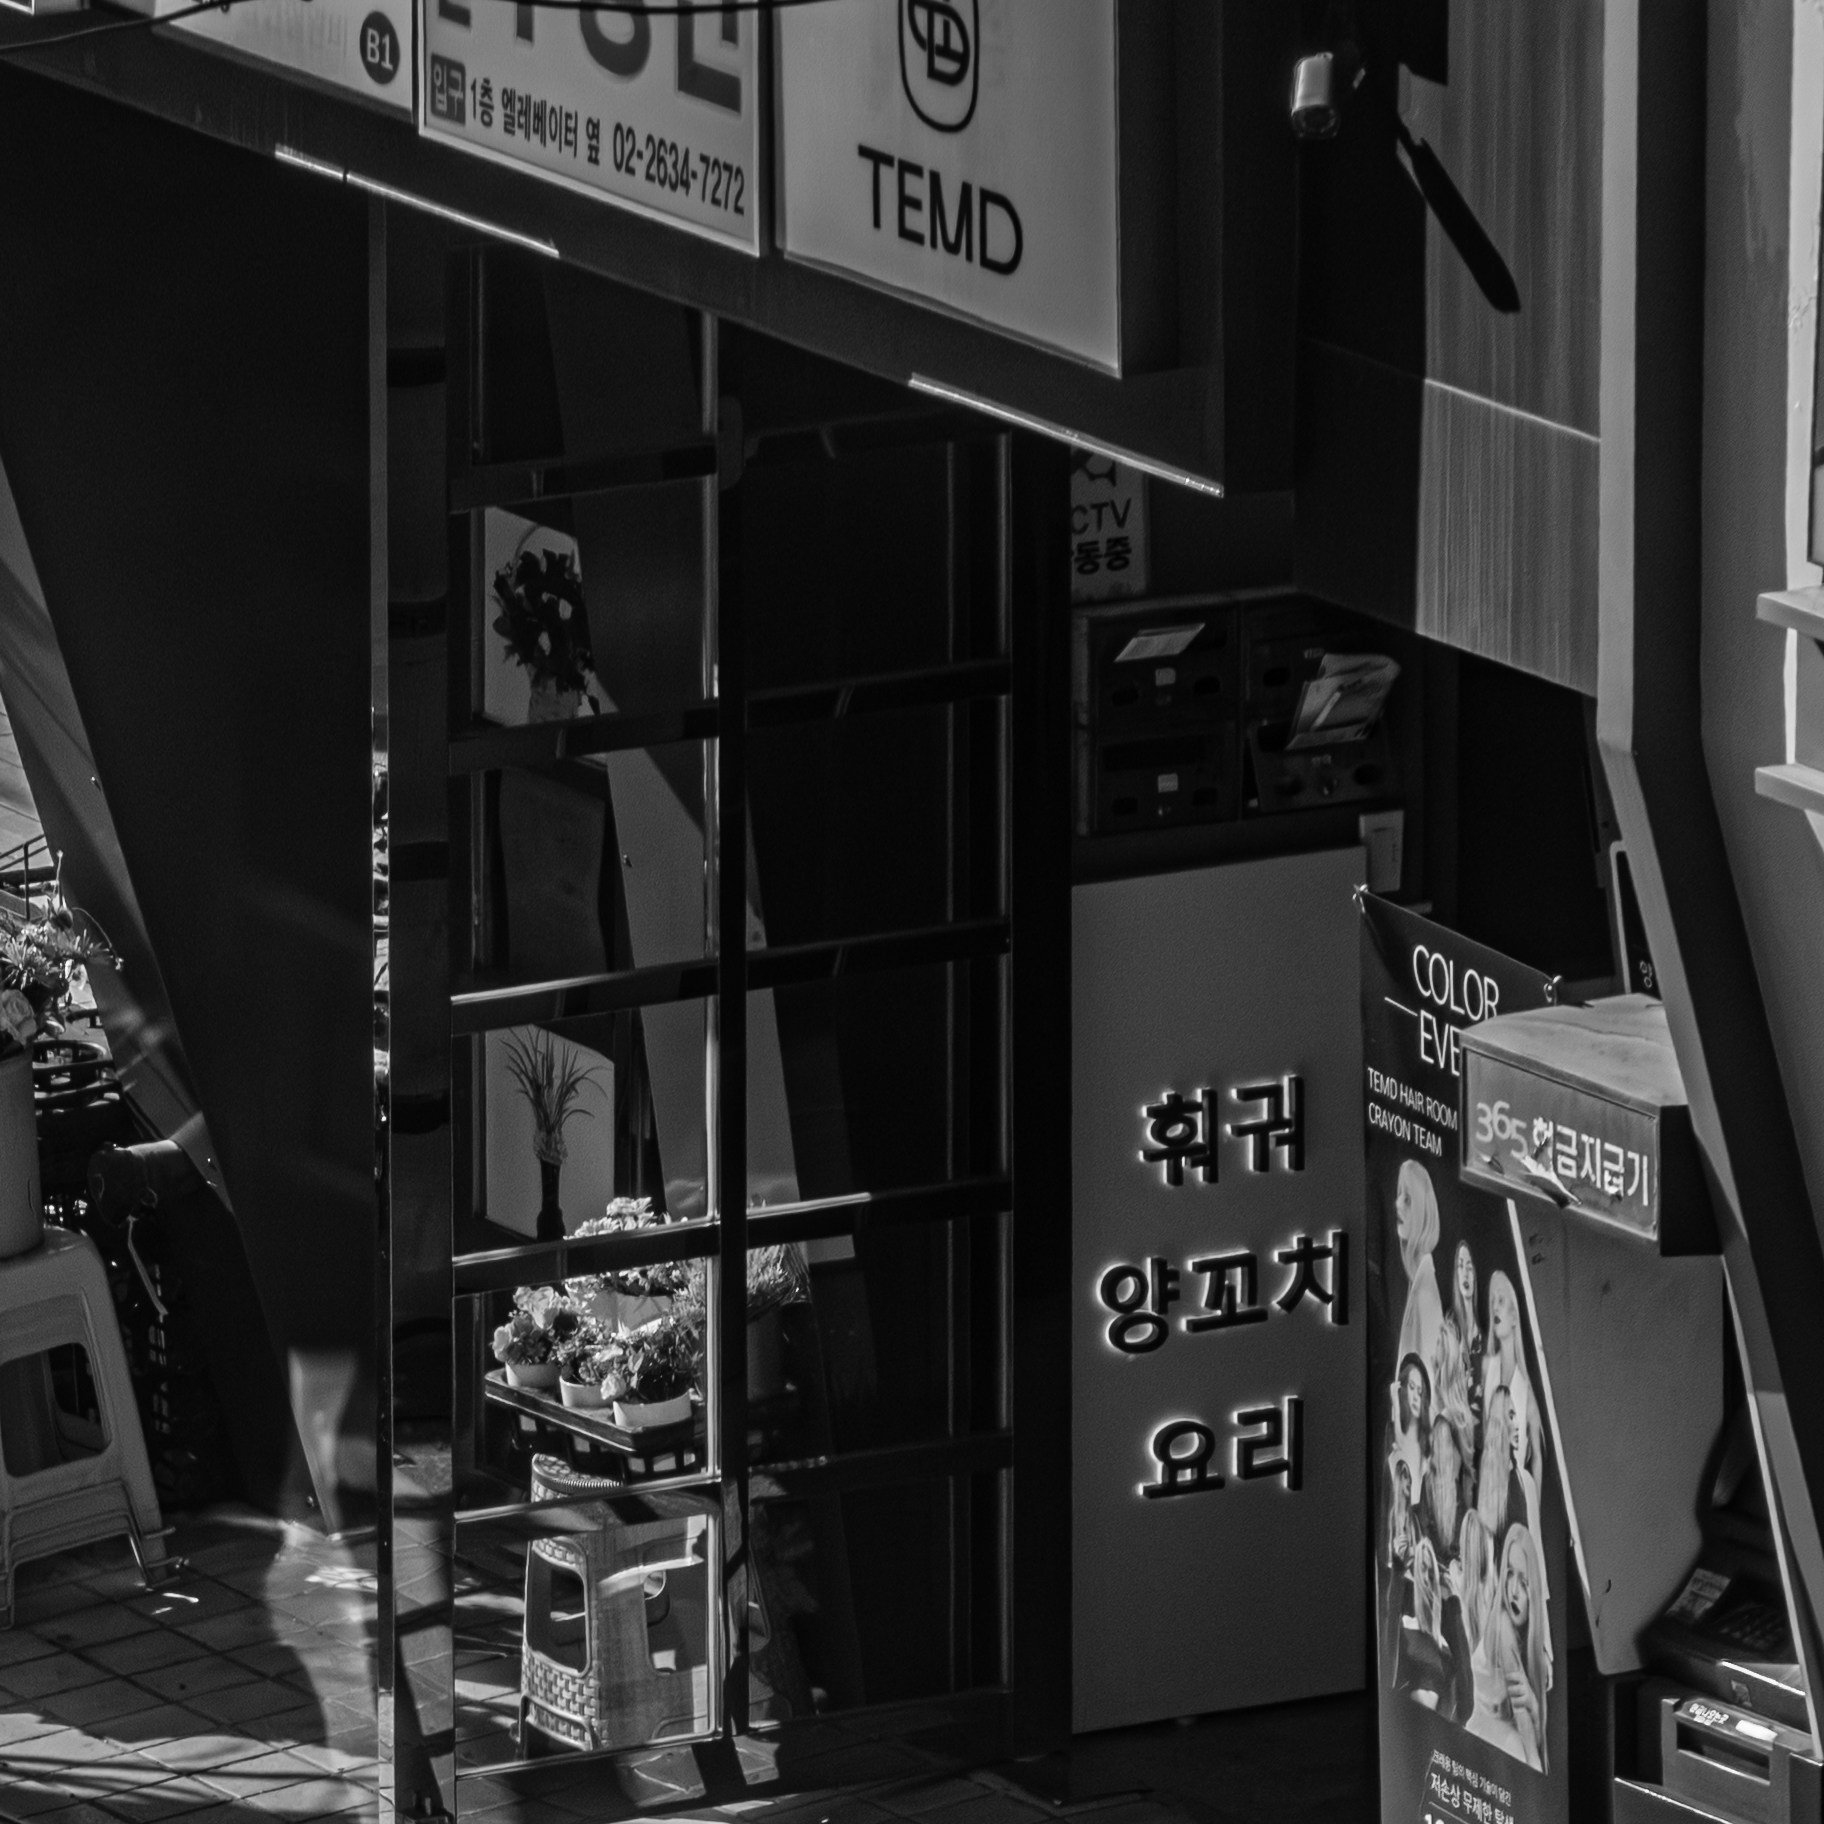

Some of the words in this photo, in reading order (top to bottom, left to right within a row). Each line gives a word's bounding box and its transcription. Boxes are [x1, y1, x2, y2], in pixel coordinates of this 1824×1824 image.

[366, 27, 393, 72] B1
[432, 62, 464, 118] 입구
[471, 77, 494, 128] 1층
[502, 88, 577, 158] 엘레베이터
[586, 117, 600, 166] 옆
[613, 122, 744, 216] 02-2634-7272
[857, 144, 1023, 275] TEMD
[1073, 536, 1132, 575] 동중
[1413, 944, 1499, 1021] COLOR
[1139, 1073, 1305, 1186] 훠궈
[1367, 1066, 1398, 1100] TEMD
[1400, 1082, 1425, 1115] HAIR
[1426, 1096, 1458, 1132] ROOM
[1368, 1102, 1411, 1141] CRAYON
[1413, 1123, 1443, 1157] TEAM
[1476, 1100, 1527, 1161] 365
[1532, 1116, 1649, 1207] 현금지급기
[1099, 1228, 1349, 1355] 양꼬치
[1138, 1395, 1304, 1498] 요리
[1430, 1772, 1461, 1808] 저손상
